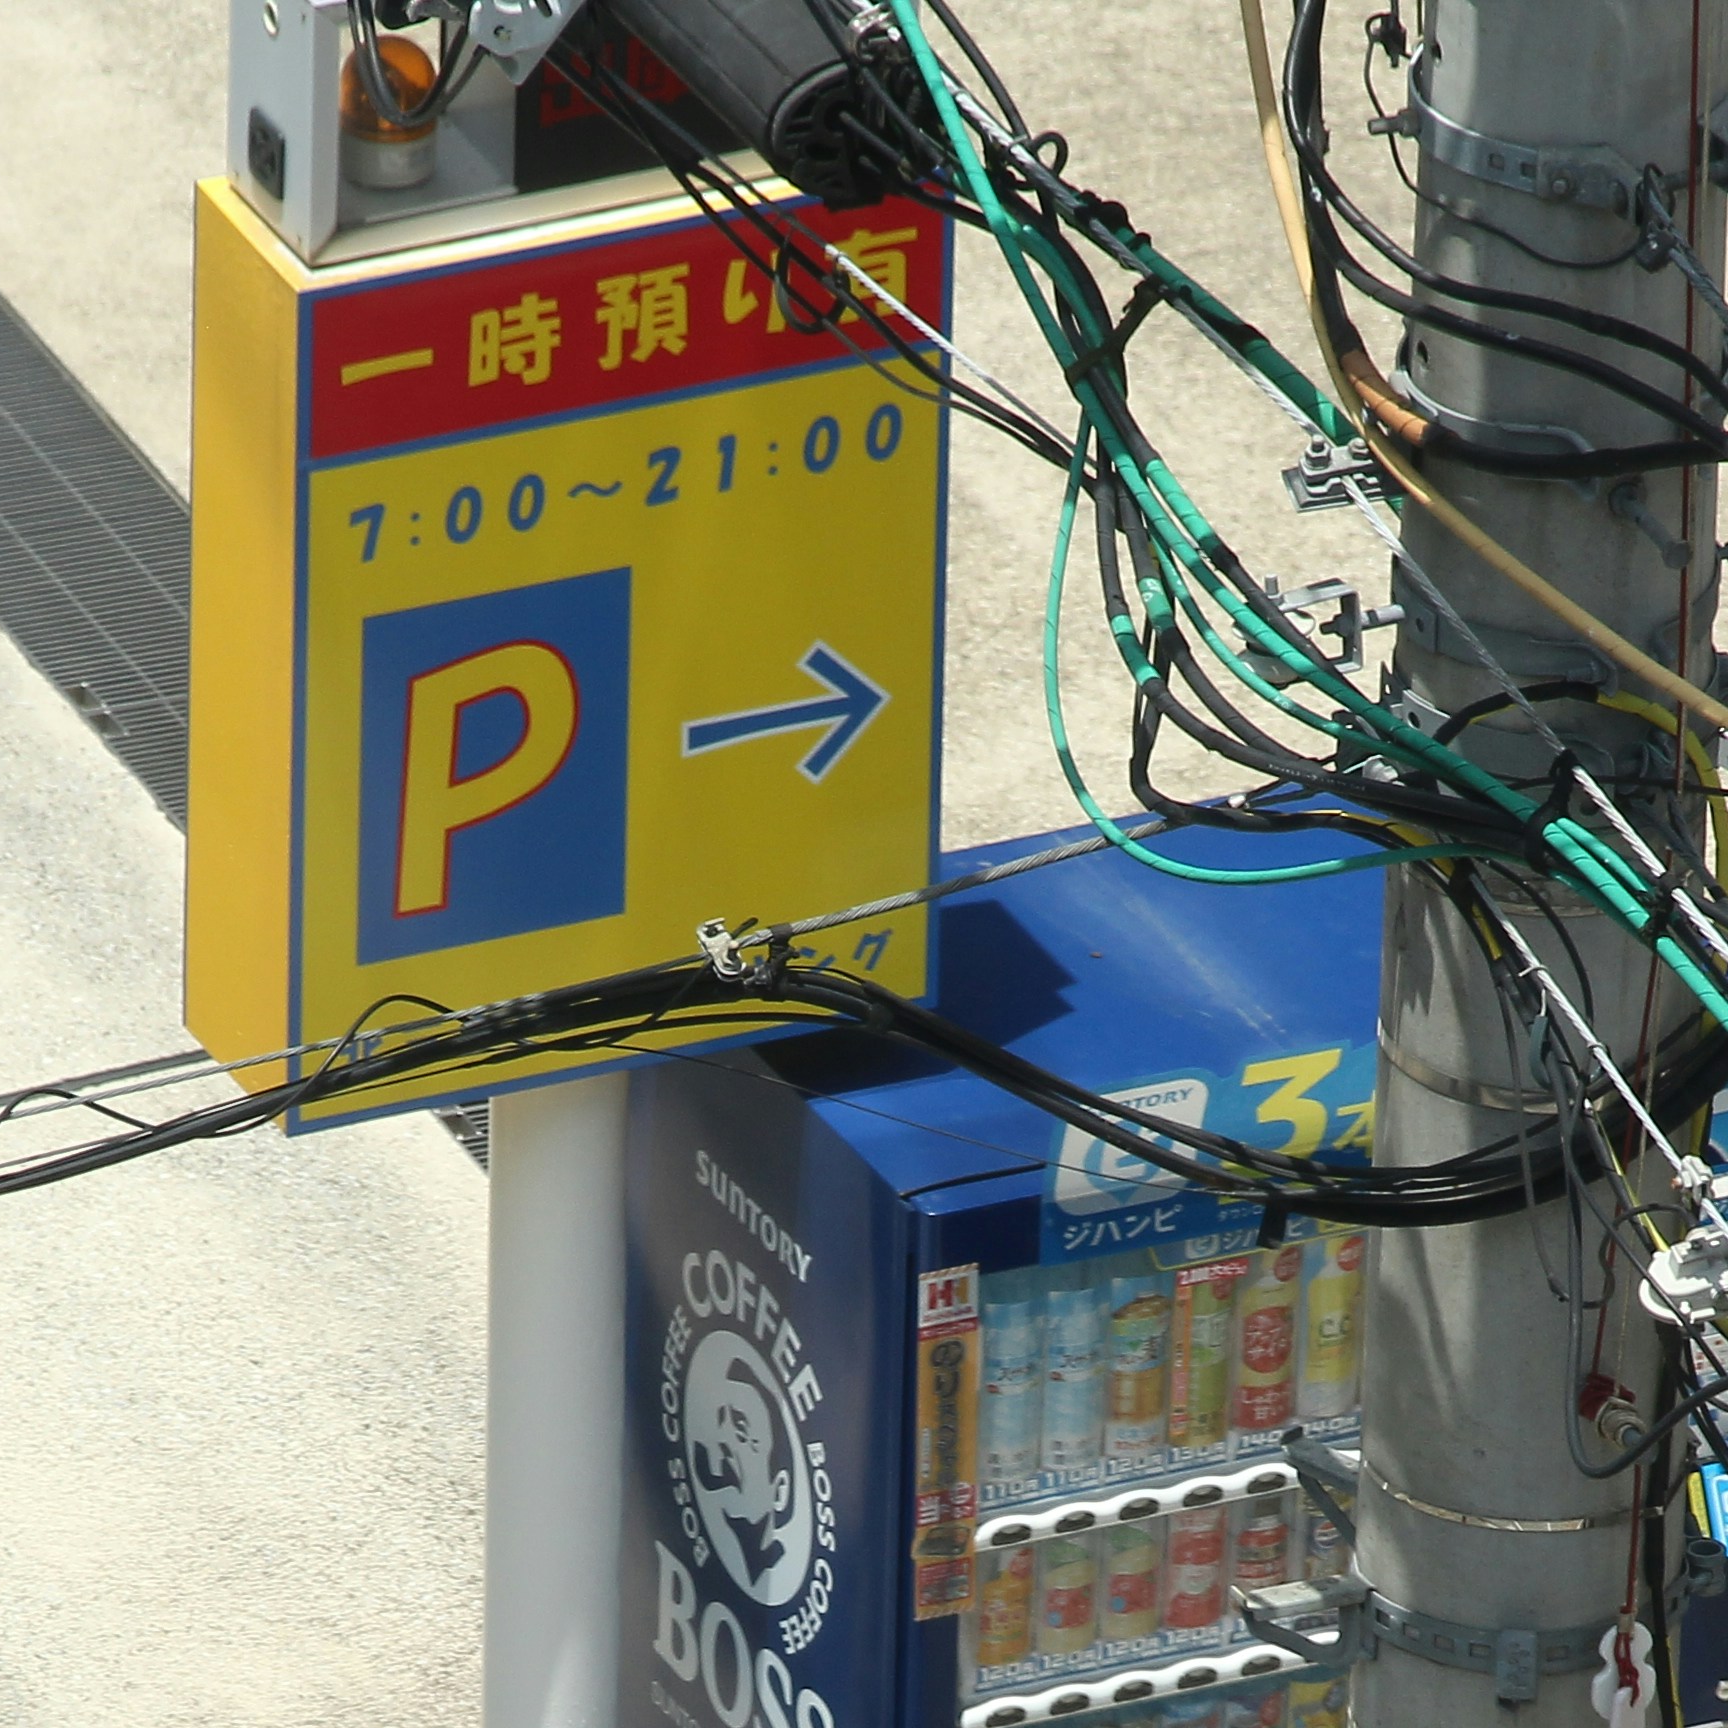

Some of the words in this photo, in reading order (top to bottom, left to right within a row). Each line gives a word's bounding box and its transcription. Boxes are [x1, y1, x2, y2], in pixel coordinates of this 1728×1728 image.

[392, 637, 580, 919] P
[695, 1149, 813, 1283] SUNTORY
[1062, 1204, 1184, 1250] ジハンピ
[681, 1249, 824, 1423] COFFEE
[805, 1440, 837, 1554] BOSS
[777, 1556, 835, 1656] COFFEE
